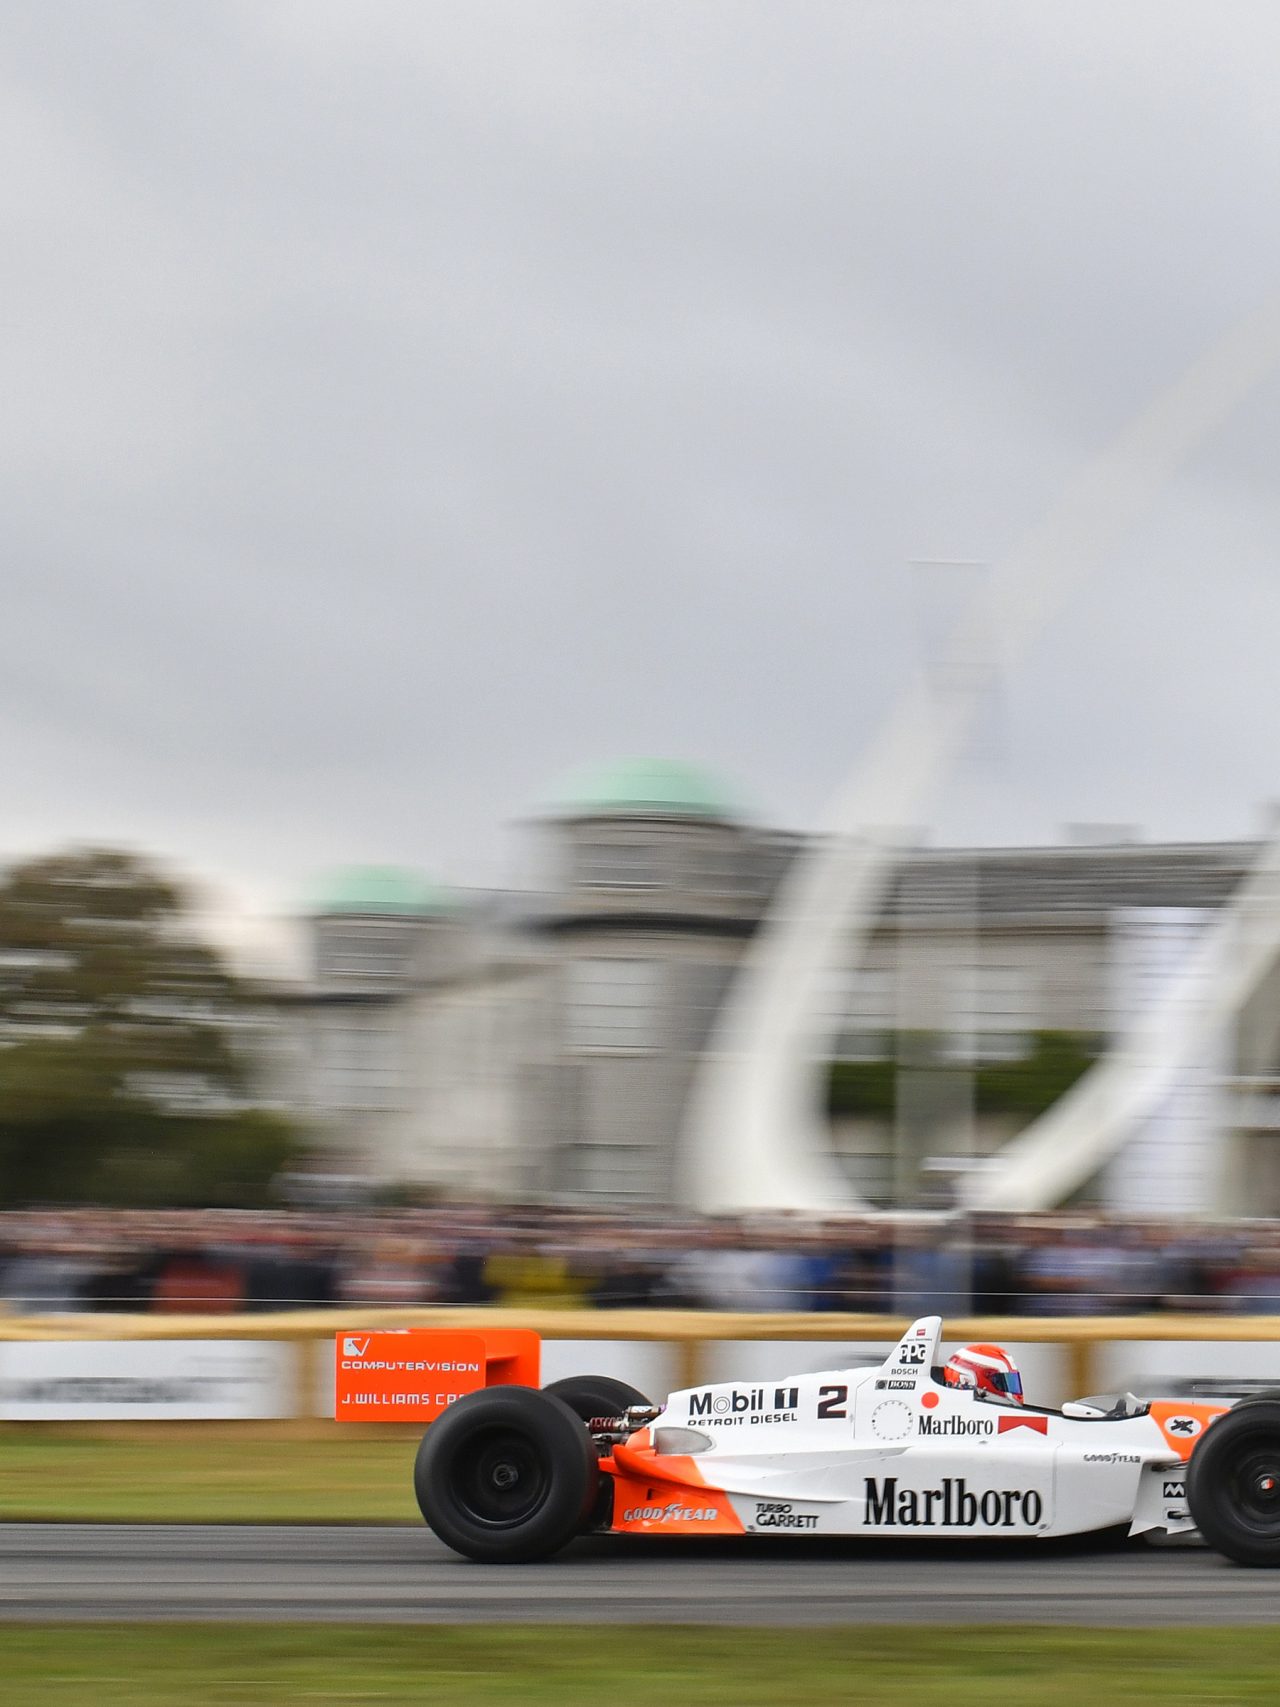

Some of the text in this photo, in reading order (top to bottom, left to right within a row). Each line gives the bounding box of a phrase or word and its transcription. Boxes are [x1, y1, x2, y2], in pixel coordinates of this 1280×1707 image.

[889, 1381, 915, 1389] BOSS
[341, 1393, 464, 1405] J.WILLIAMS CA
[689, 1389, 763, 1416] Mobil
[817, 1386, 848, 1419] 2
[688, 1413, 798, 1426] DETROIT DIESEL
[918, 1415, 993, 1435] Marlboro
[756, 1503, 792, 1513] TURBO
[863, 1477, 1042, 1526] Marlboro
[756, 1514, 819, 1528] GARRETT
